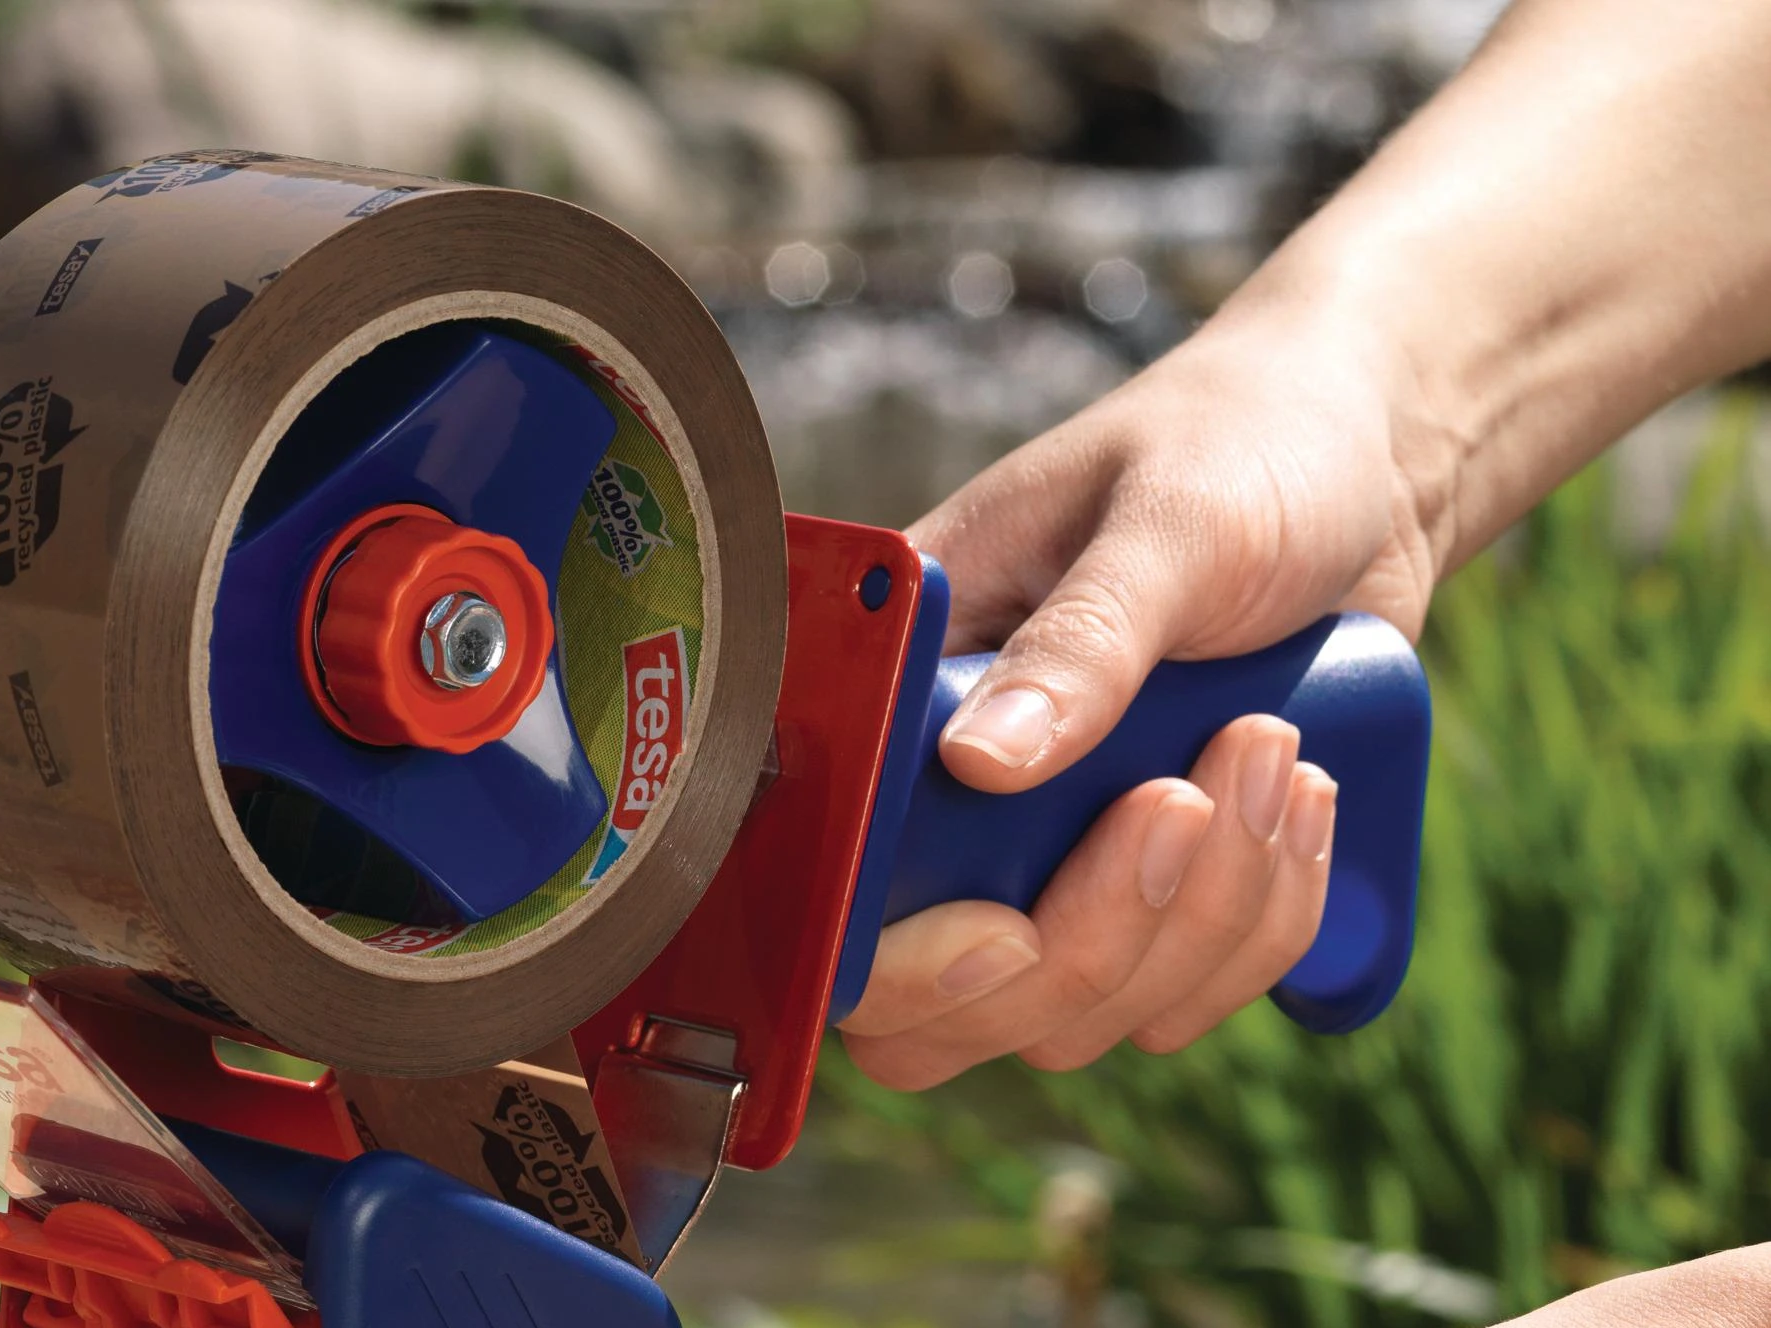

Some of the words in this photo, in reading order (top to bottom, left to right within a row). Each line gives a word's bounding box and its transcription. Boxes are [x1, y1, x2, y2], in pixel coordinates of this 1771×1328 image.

[22, 375, 54, 457] plastic
[15, 464, 36, 572] recycled
[594, 467, 644, 552] 100%
[603, 522, 630, 574] plastic
[625, 651, 675, 811] tesa
[518, 1080, 570, 1156] plastic
[561, 1162, 616, 1246] ecycled
